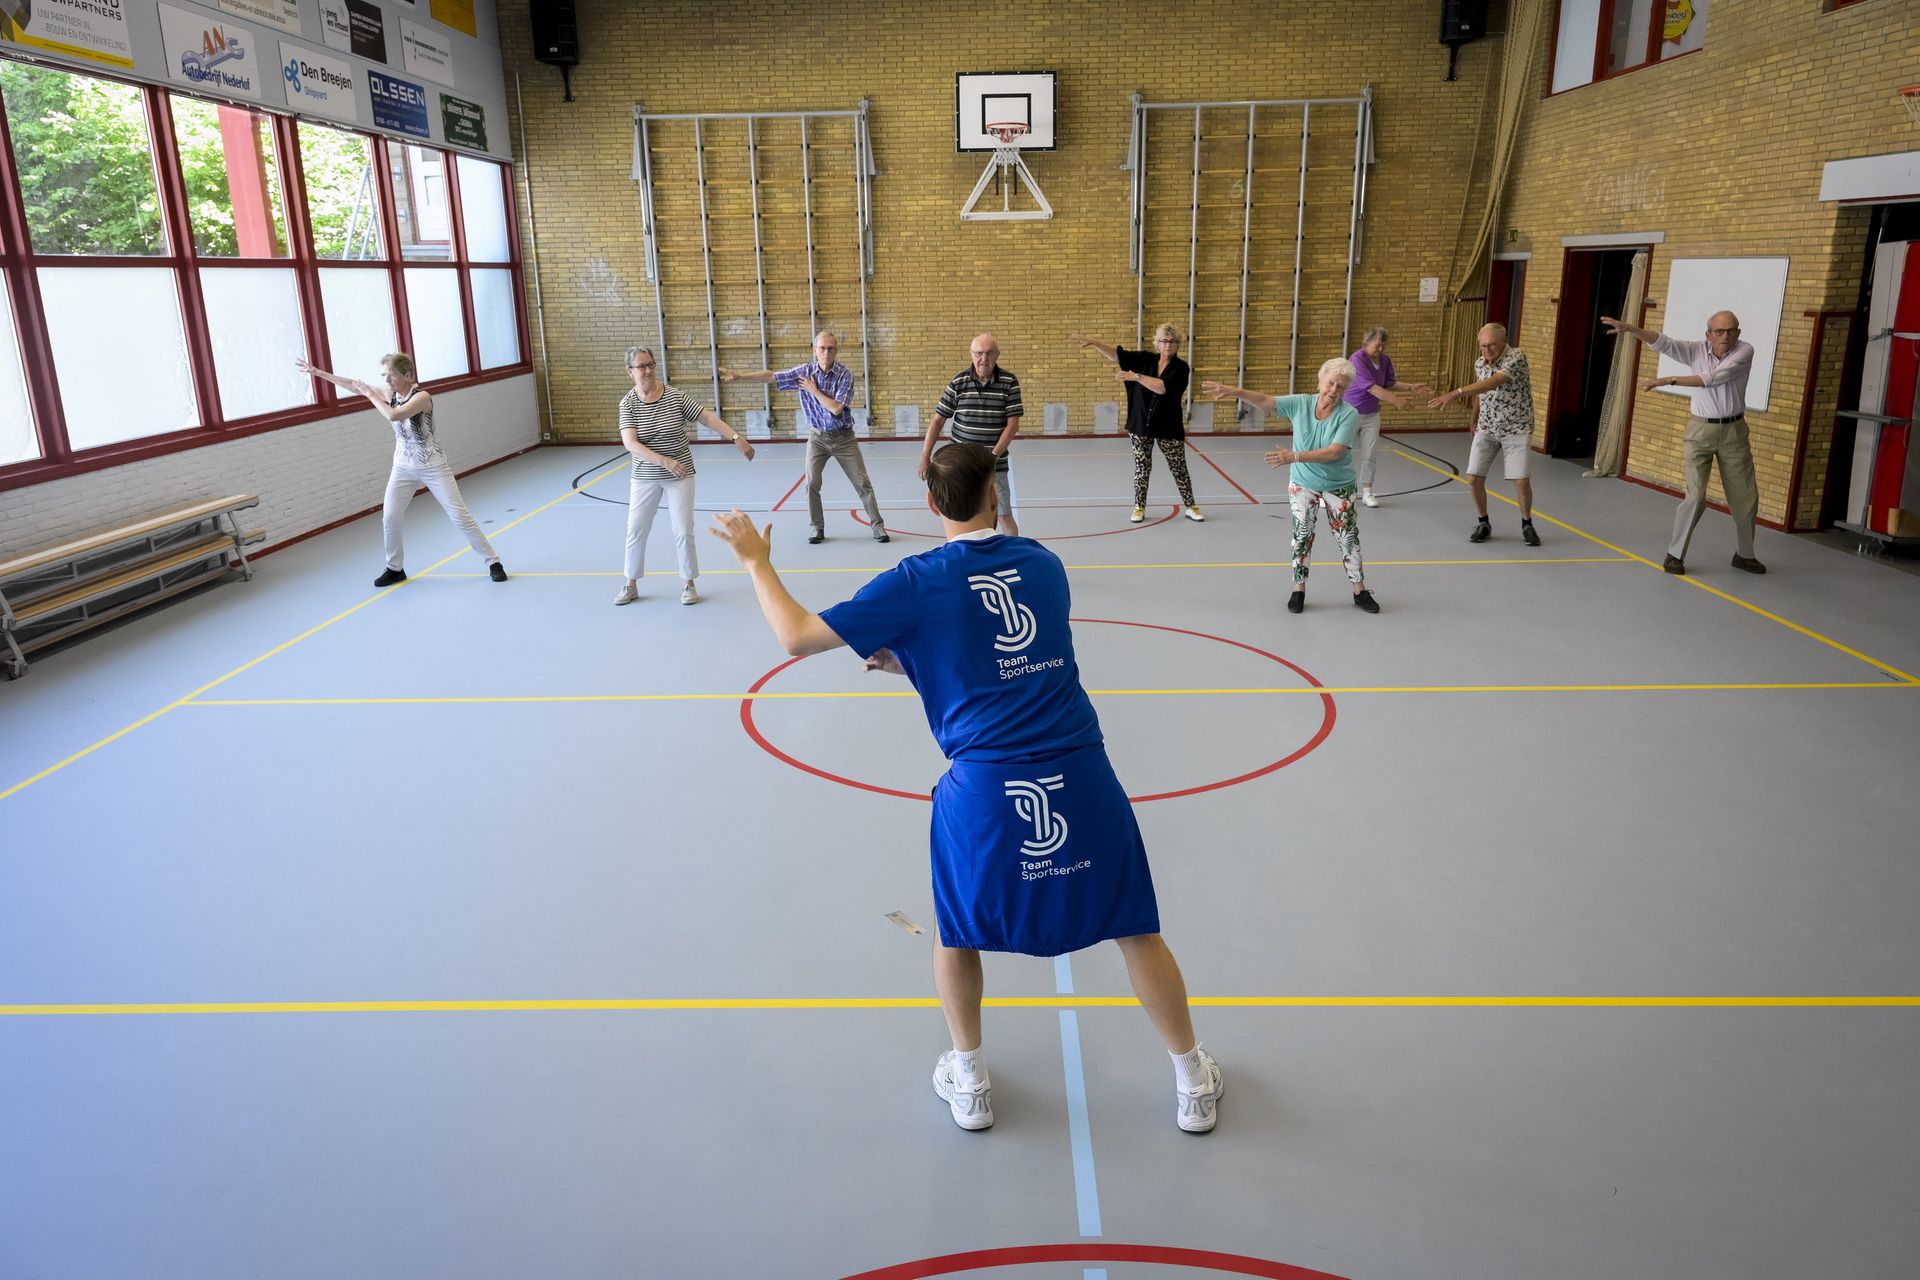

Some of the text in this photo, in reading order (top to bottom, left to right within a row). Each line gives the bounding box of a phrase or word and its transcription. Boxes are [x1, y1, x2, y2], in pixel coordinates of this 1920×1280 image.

[37, 8, 49, 18] UW
[50, 11, 80, 28] PARTNER
[68, 28, 78, 39] EN
[182, 61, 251, 91] Autobedrijf Nederhof
[301, 61, 352, 90] Den Breejen
[370, 76, 425, 107] OLSSEN
[997, 655, 1028, 669] Team
[999, 658, 1065, 680] Sportservice
[1020, 859, 1053, 870] Team
[1021, 860, 1091, 881] Sportservice
